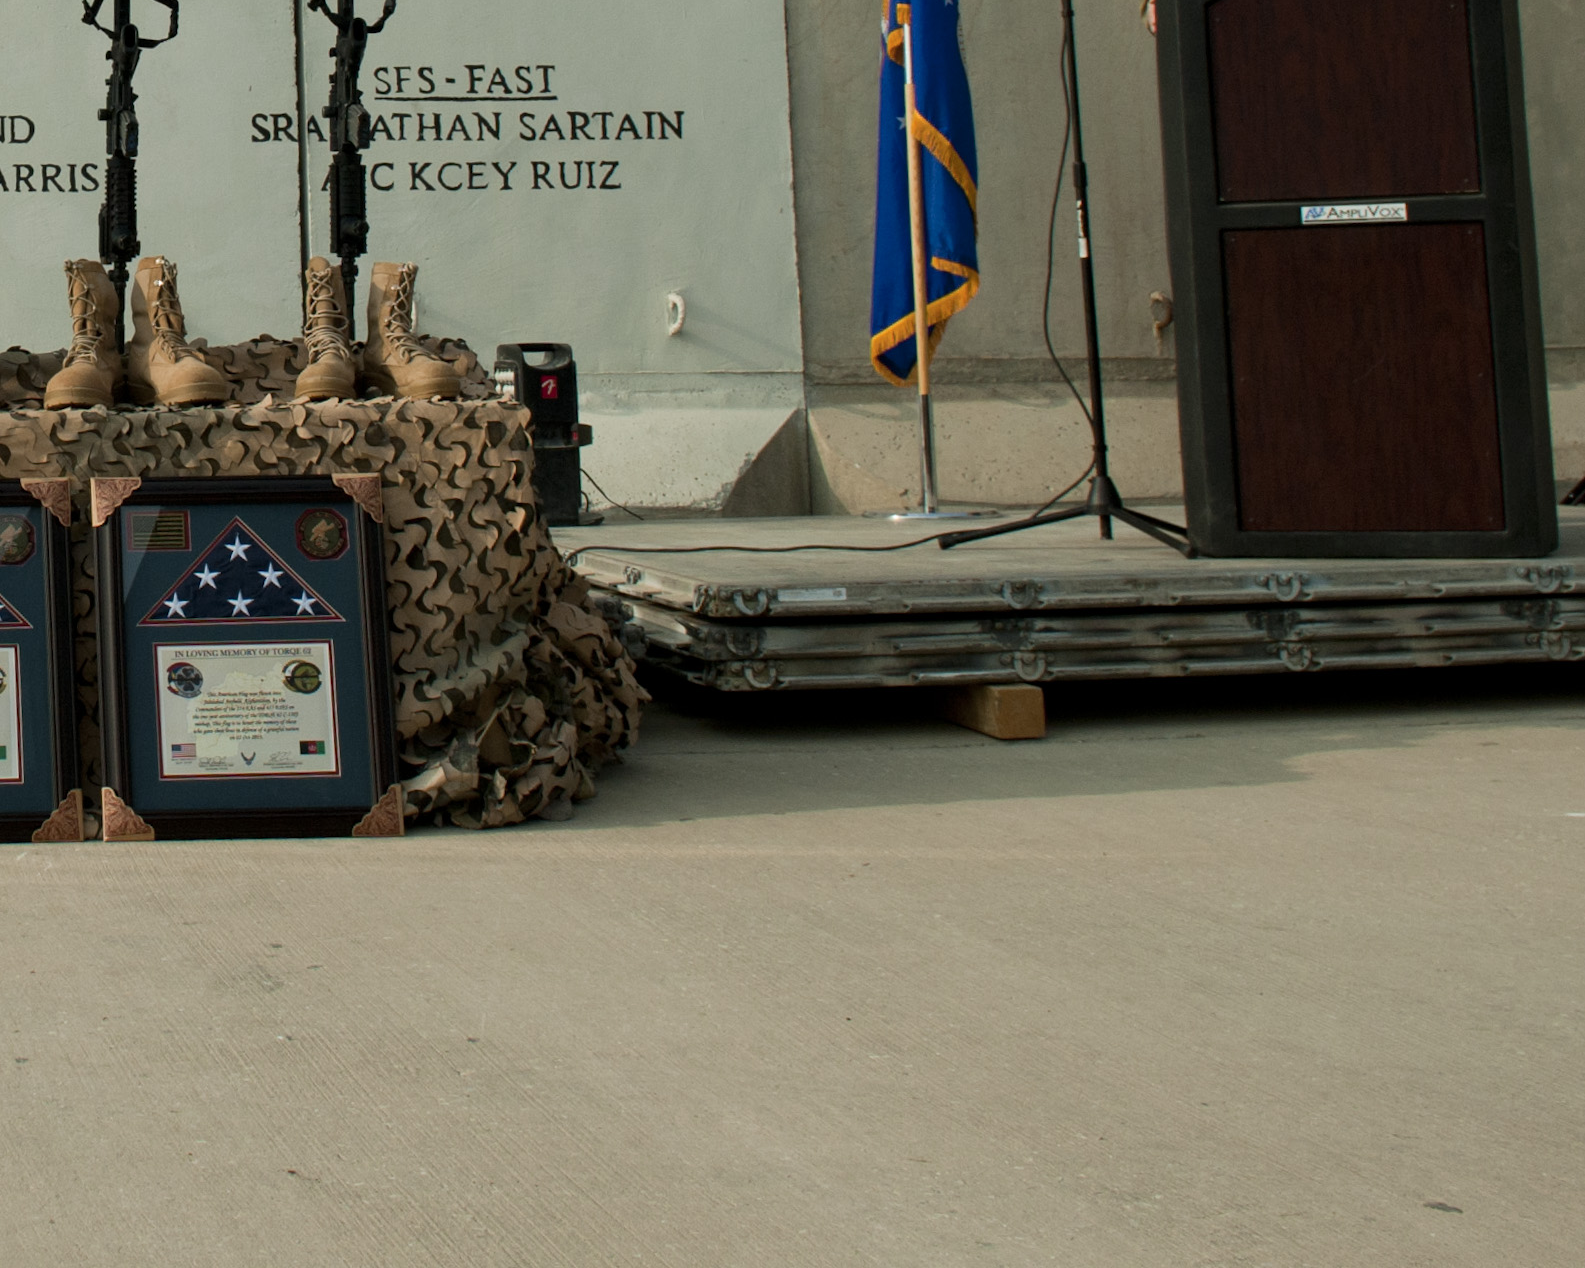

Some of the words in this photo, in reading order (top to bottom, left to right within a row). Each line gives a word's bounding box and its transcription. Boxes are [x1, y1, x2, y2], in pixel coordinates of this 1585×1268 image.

[251, 113, 328, 143] SRA
[368, 112, 502, 141] ATHAN
[519, 110, 685, 141] SARTAIN
[408, 161, 519, 192] KCEY
[530, 160, 622, 191] RUIZ
[220, 649, 257, 657] MEMORY
